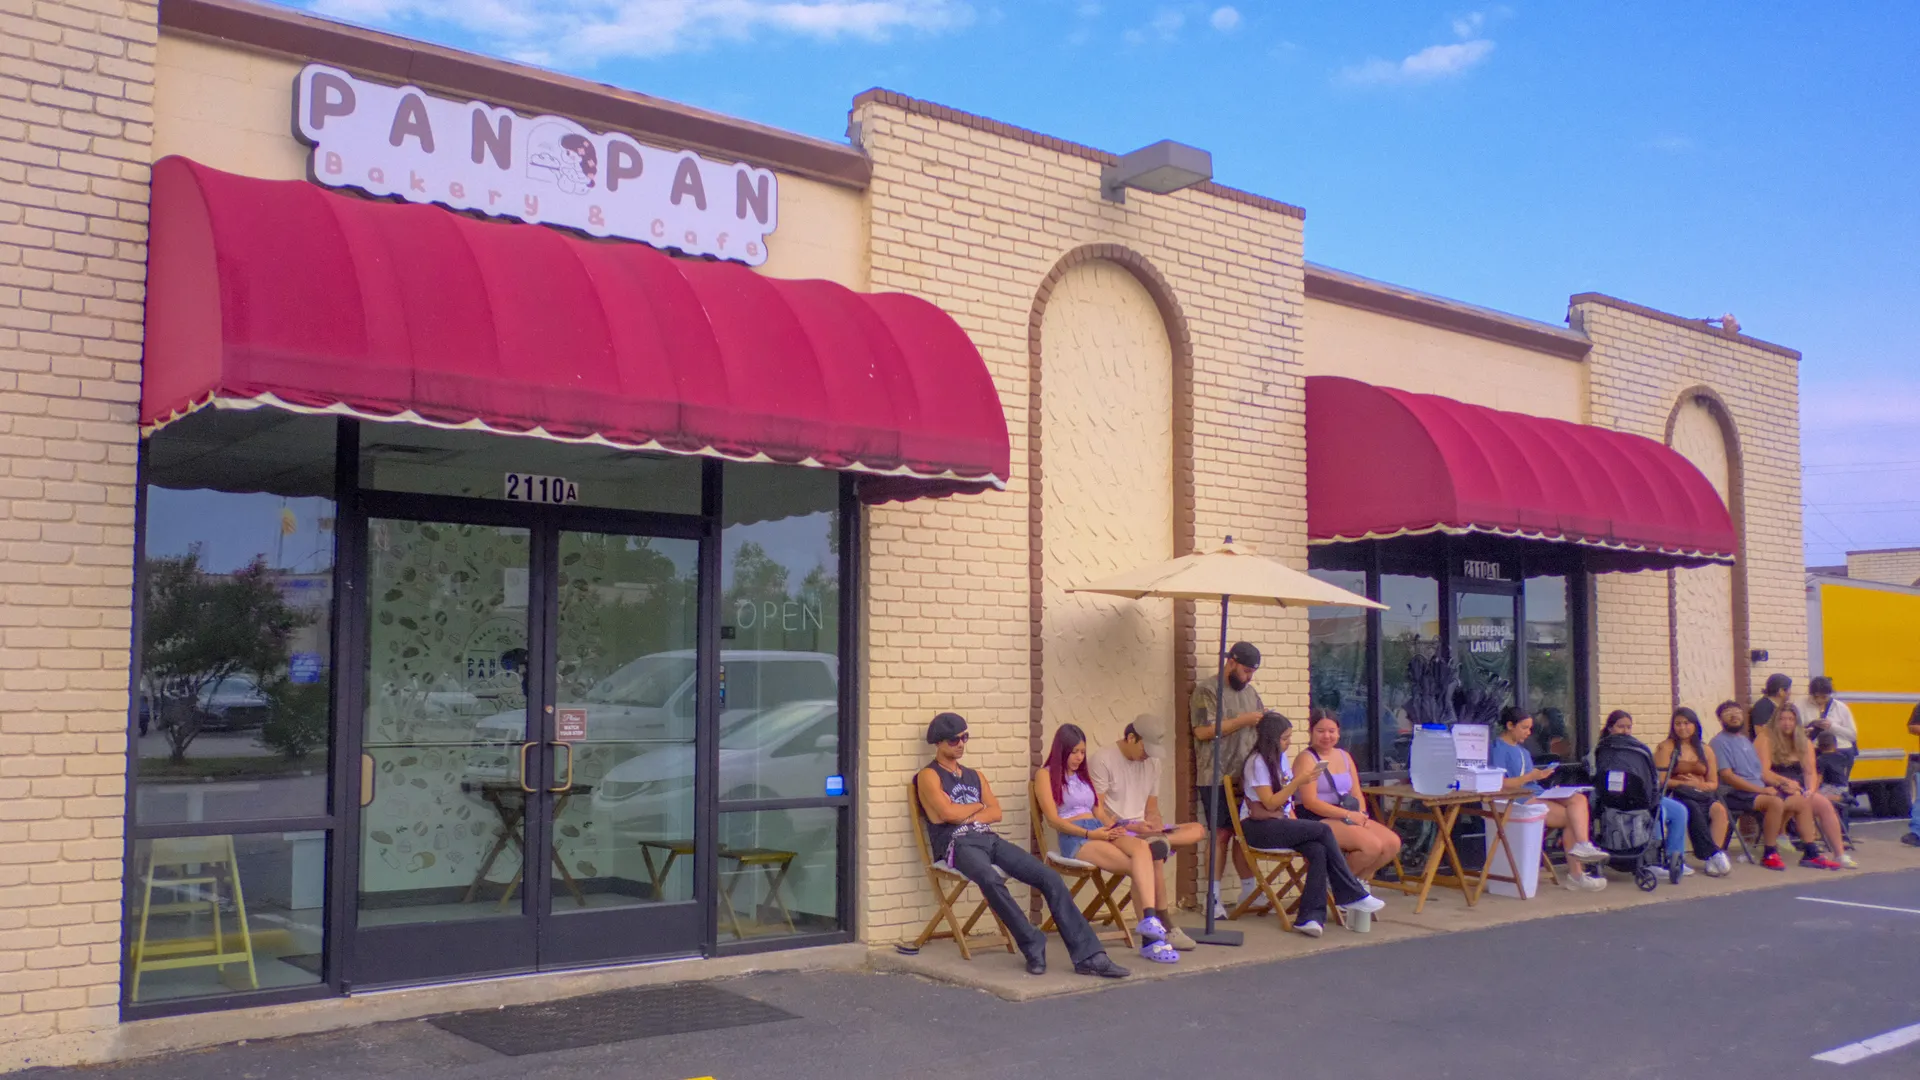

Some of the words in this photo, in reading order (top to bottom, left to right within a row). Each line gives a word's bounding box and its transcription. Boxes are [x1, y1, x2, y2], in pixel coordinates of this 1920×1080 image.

[310, 72, 512, 170] PAN
[606, 139, 769, 225] PAN
[325, 151, 538, 216] Bakery
[587, 205, 604, 227] &
[507, 473, 577, 503] 2110A
[737, 600, 823, 631] OPEN
[1458, 624, 1469, 636] MI
[467, 657, 496, 668] PAN
[467, 668, 496, 679] PAN
